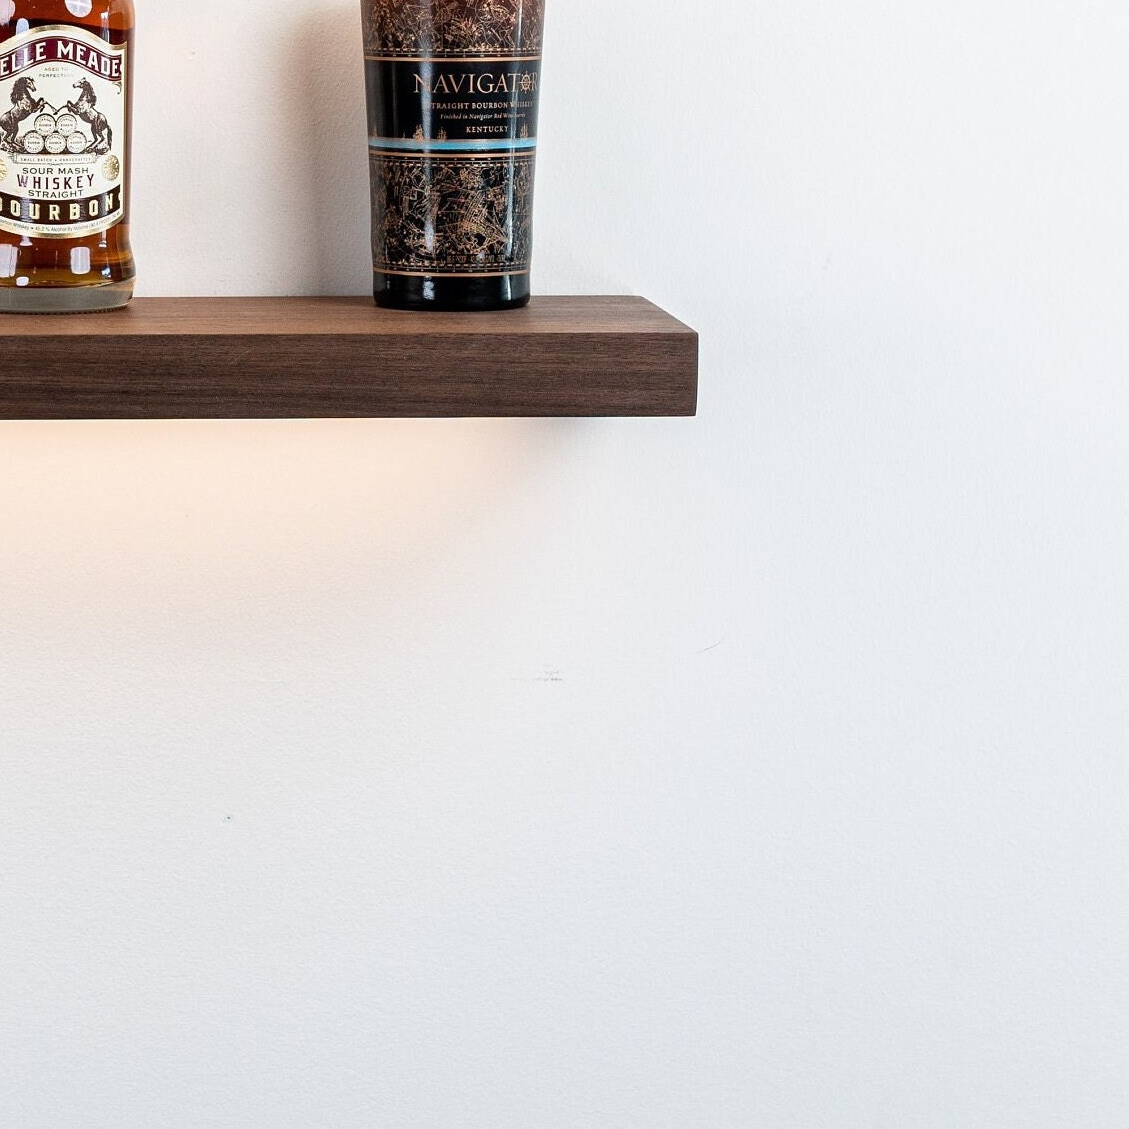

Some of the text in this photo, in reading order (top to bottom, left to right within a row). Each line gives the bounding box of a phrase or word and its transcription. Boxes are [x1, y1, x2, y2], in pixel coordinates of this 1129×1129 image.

[57, 40, 120, 77] MEADE
[472, 101, 508, 109] BOURBON
[22, 167, 89, 175] SOUR MASH
[17, 174, 94, 189] WHISKEY
[28, 189, 84, 199] STRAIGHT
